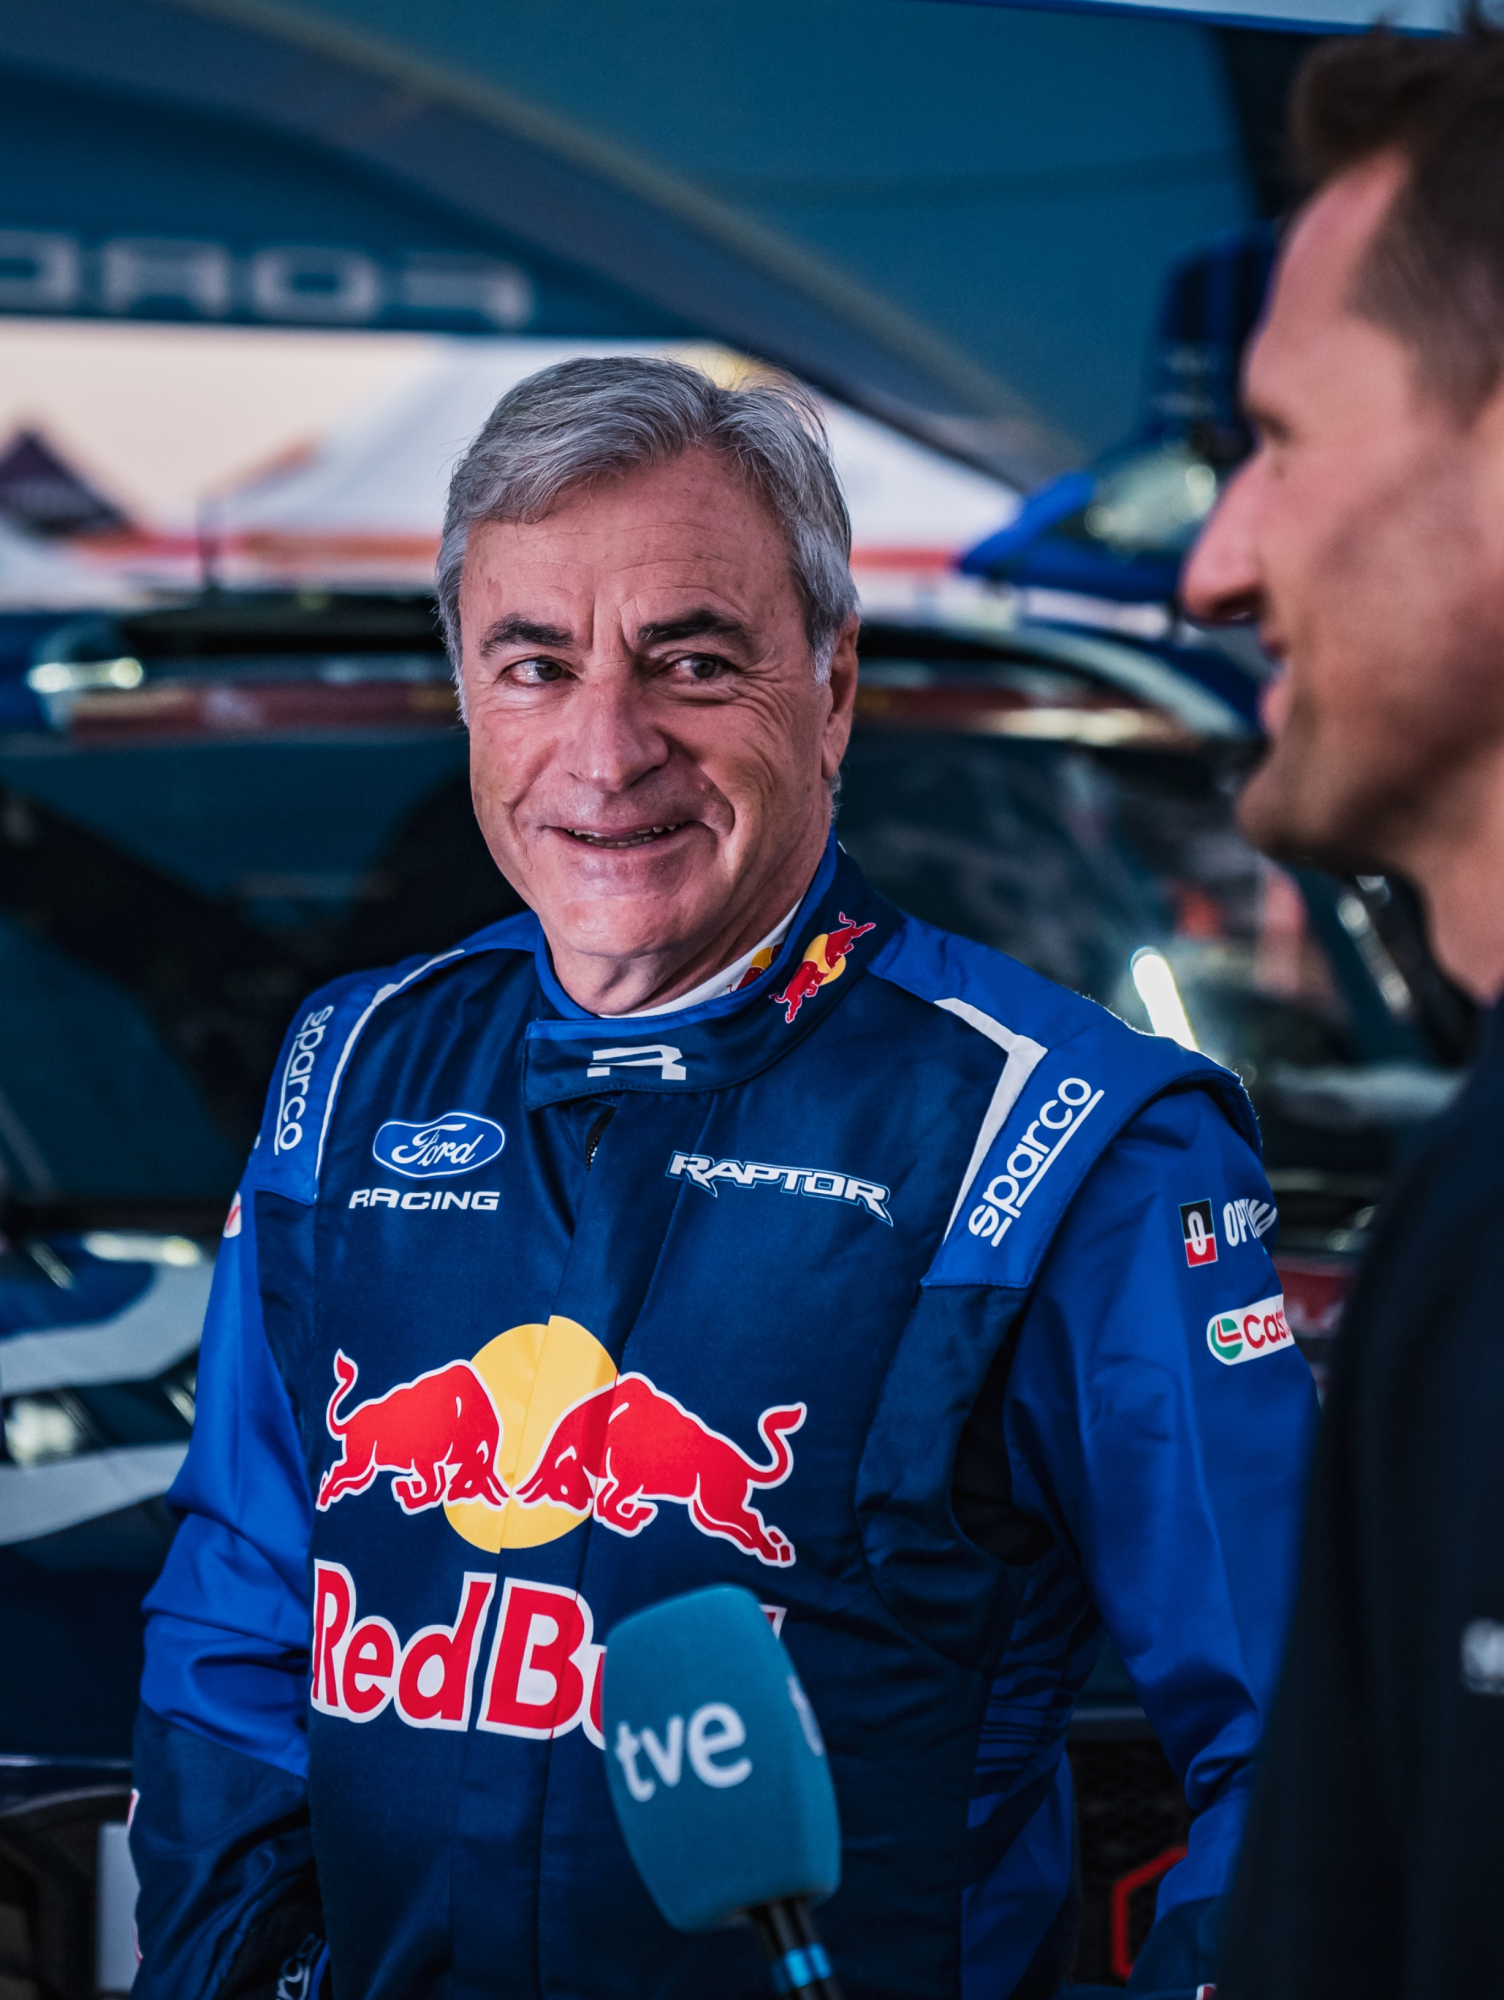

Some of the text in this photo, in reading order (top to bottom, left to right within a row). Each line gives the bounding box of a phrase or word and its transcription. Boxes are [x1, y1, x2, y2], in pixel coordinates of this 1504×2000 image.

[275, 1005, 334, 1155] sparco
[391, 1123, 485, 1167] Ford
[666, 1151, 893, 1227] RAPTOR
[968, 1077, 1104, 1247] sparco
[348, 1188, 500, 1210] RACING
[311, 1558, 497, 1731] Red
[616, 1703, 752, 1801] tve
